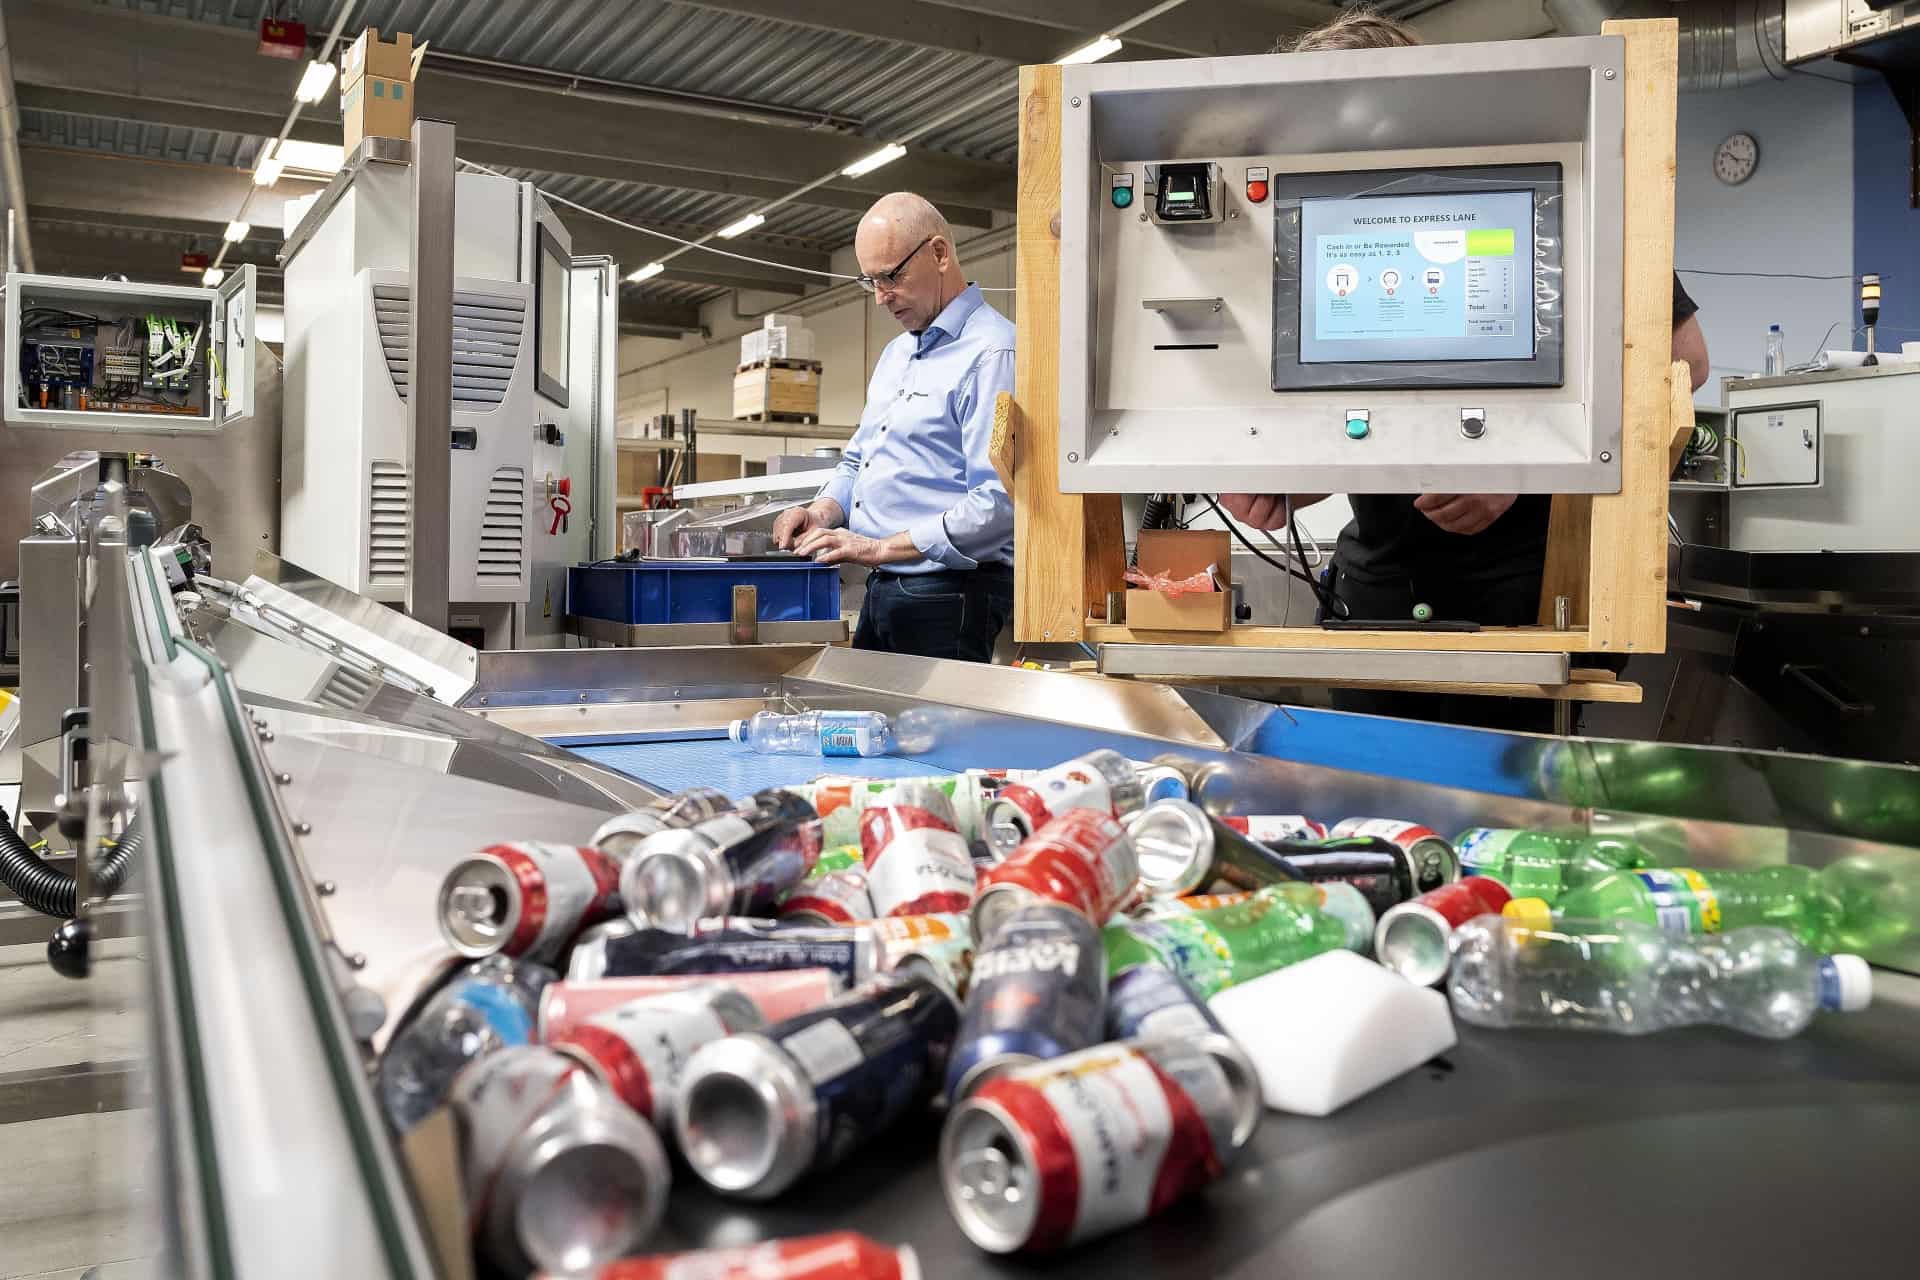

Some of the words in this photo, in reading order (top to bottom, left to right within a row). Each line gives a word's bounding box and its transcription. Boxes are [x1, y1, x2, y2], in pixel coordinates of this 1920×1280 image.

[1353, 216, 1397, 225] WELCOME
[1399, 216, 1411, 224] TO
[1413, 214, 1451, 223] EXPRESS
[1453, 213, 1477, 222] LANE
[1374, 241, 1410, 249] Rewarded
